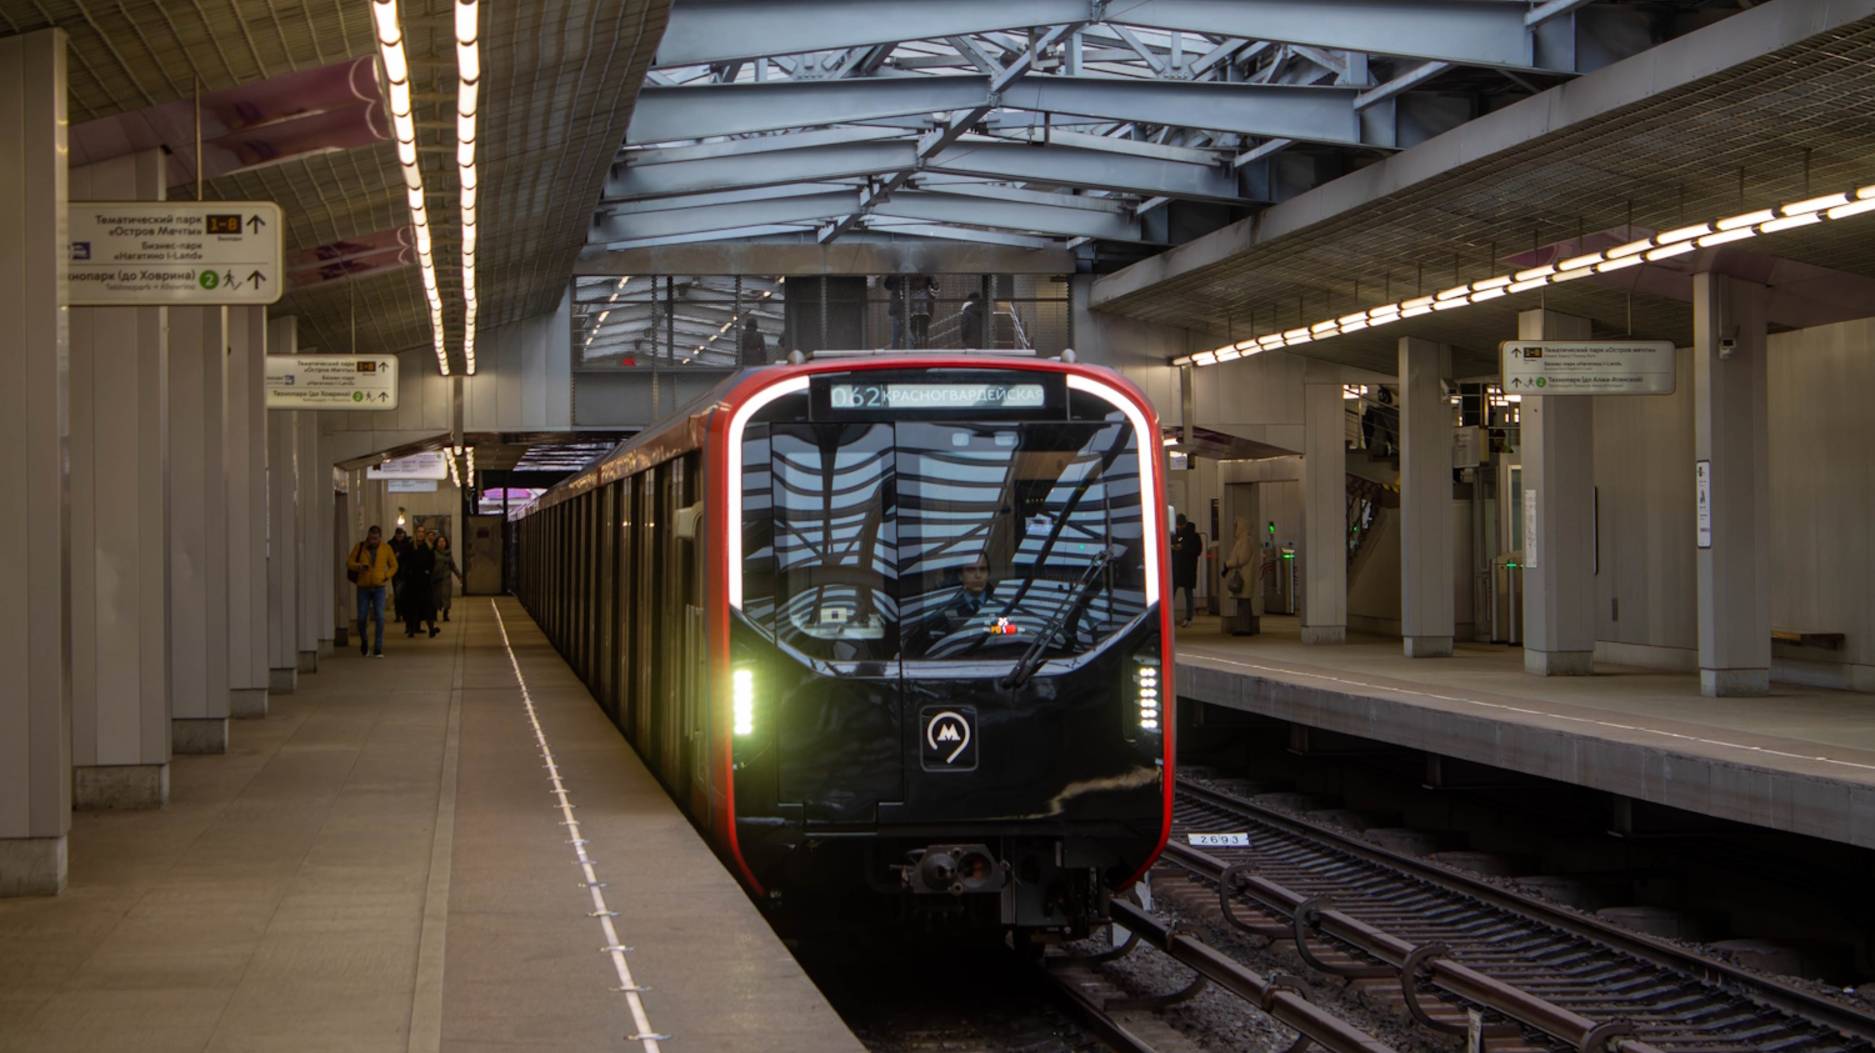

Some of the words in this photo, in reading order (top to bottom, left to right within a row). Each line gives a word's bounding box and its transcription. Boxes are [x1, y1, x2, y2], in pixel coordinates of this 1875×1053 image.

[95, 214, 173, 225] Тематический
[175, 216, 202, 226] парк
[118, 270, 137, 282] (до
[140, 270, 196, 283] Ховрина)
[831, 386, 881, 407] 062
[1200, 835, 1239, 844] 2693
